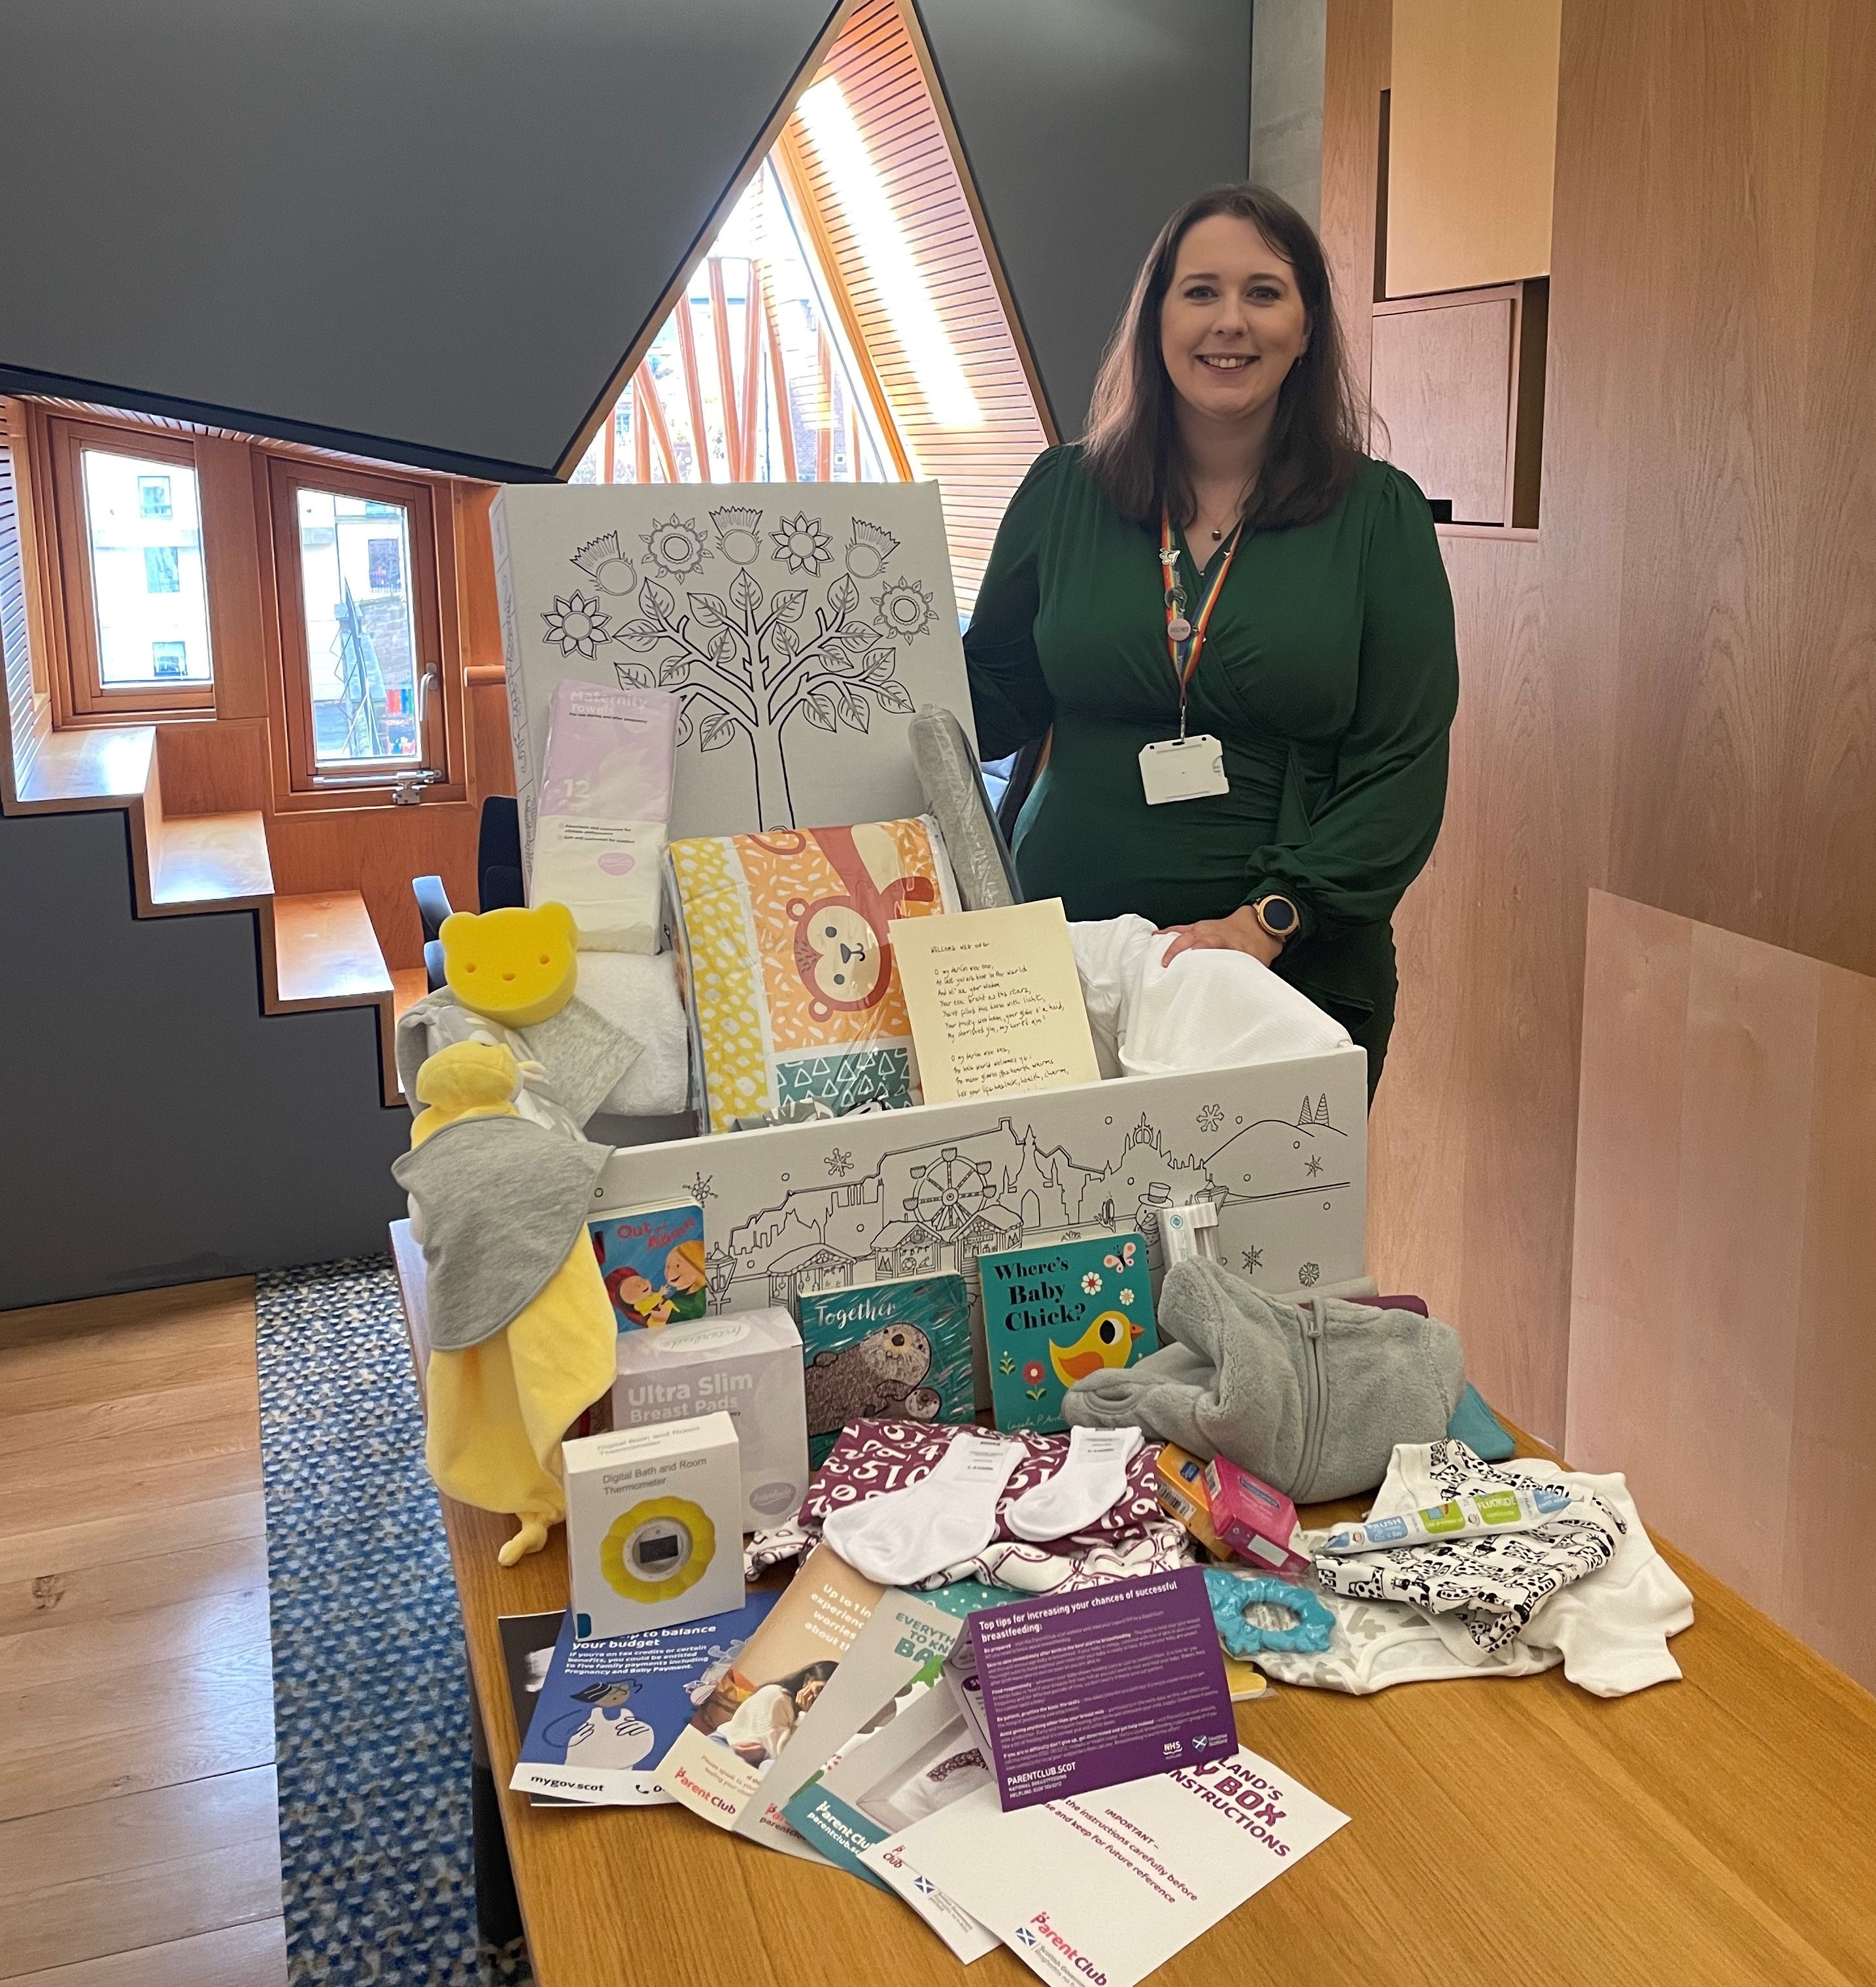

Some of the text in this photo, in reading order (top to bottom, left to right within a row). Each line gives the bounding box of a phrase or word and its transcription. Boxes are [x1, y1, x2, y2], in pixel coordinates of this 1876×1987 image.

[570, 691, 647, 709] Maternity
[571, 703, 615, 715] Towels
[564, 779, 588, 797] 12
[930, 945, 956, 953] WELCOME
[617, 1221, 650, 1240] Out
[647, 1216, 696, 1252] About
[993, 1257, 1070, 1281] Where's
[1009, 1282, 1066, 1306] Baby
[815, 1298, 896, 1329] Together
[1004, 1302, 1087, 1332] Chick?
[627, 1372, 753, 1406] Ultra Slim
[630, 1395, 740, 1423] Breast Pads
[603, 1457, 707, 1485] Digital Bath and Room
[603, 1476, 668, 1495] Thermometer
[1476, 1495, 1517, 1510] FLUORIDE
[810, 1593, 865, 1629] experienc
[823, 1583, 838, 1599] Up
[839, 1594, 853, 1608] to
[859, 1606, 872, 1619] in
[979, 1580, 1178, 1631] Top tips for increasing your chances of successful
[660, 1625, 717, 1637] balance
[804, 1622, 839, 1646] about
[813, 1610, 857, 1640] worries
[895, 1612, 957, 1646] EVERYTH
[981, 1623, 1043, 1643] breastfeeding:
[571, 1638, 661, 1651] your budget
[676, 1644, 708, 1653] certain
[909, 1629, 950, 1654] TO KN
[595, 1661, 624, 1670] family
[624, 1659, 668, 1669] payments
[669, 1656, 709, 1666] including
[653, 1663, 694, 1673] Payment.
[663, 1651, 698, 1660] entitled
[1163, 1740, 1182, 1752] NHS
[530, 1775, 605, 1792] mygov.scot
[1007, 1761, 1076, 1786] PARENTCLUB.SCOT
[1218, 1757, 1284, 1801] LAND'S
[674, 1766, 711, 1802] Parent
[710, 1796, 736, 1815] Club
[1214, 1775, 1287, 1827] BOX
[815, 1800, 855, 1837] Parent
[1104, 1808, 1155, 1844] IMPORTANT
[1169, 1769, 1291, 1858] NSTRUCTIONS
[806, 1811, 861, 1856] parentclub.sc
[883, 1852, 903, 1869] Club
[1044, 1803, 1176, 1904] se and keep for future reference
[1065, 1799, 1198, 1901] the instructions carefully before
[1029, 1911, 1108, 1987] Parent Club
